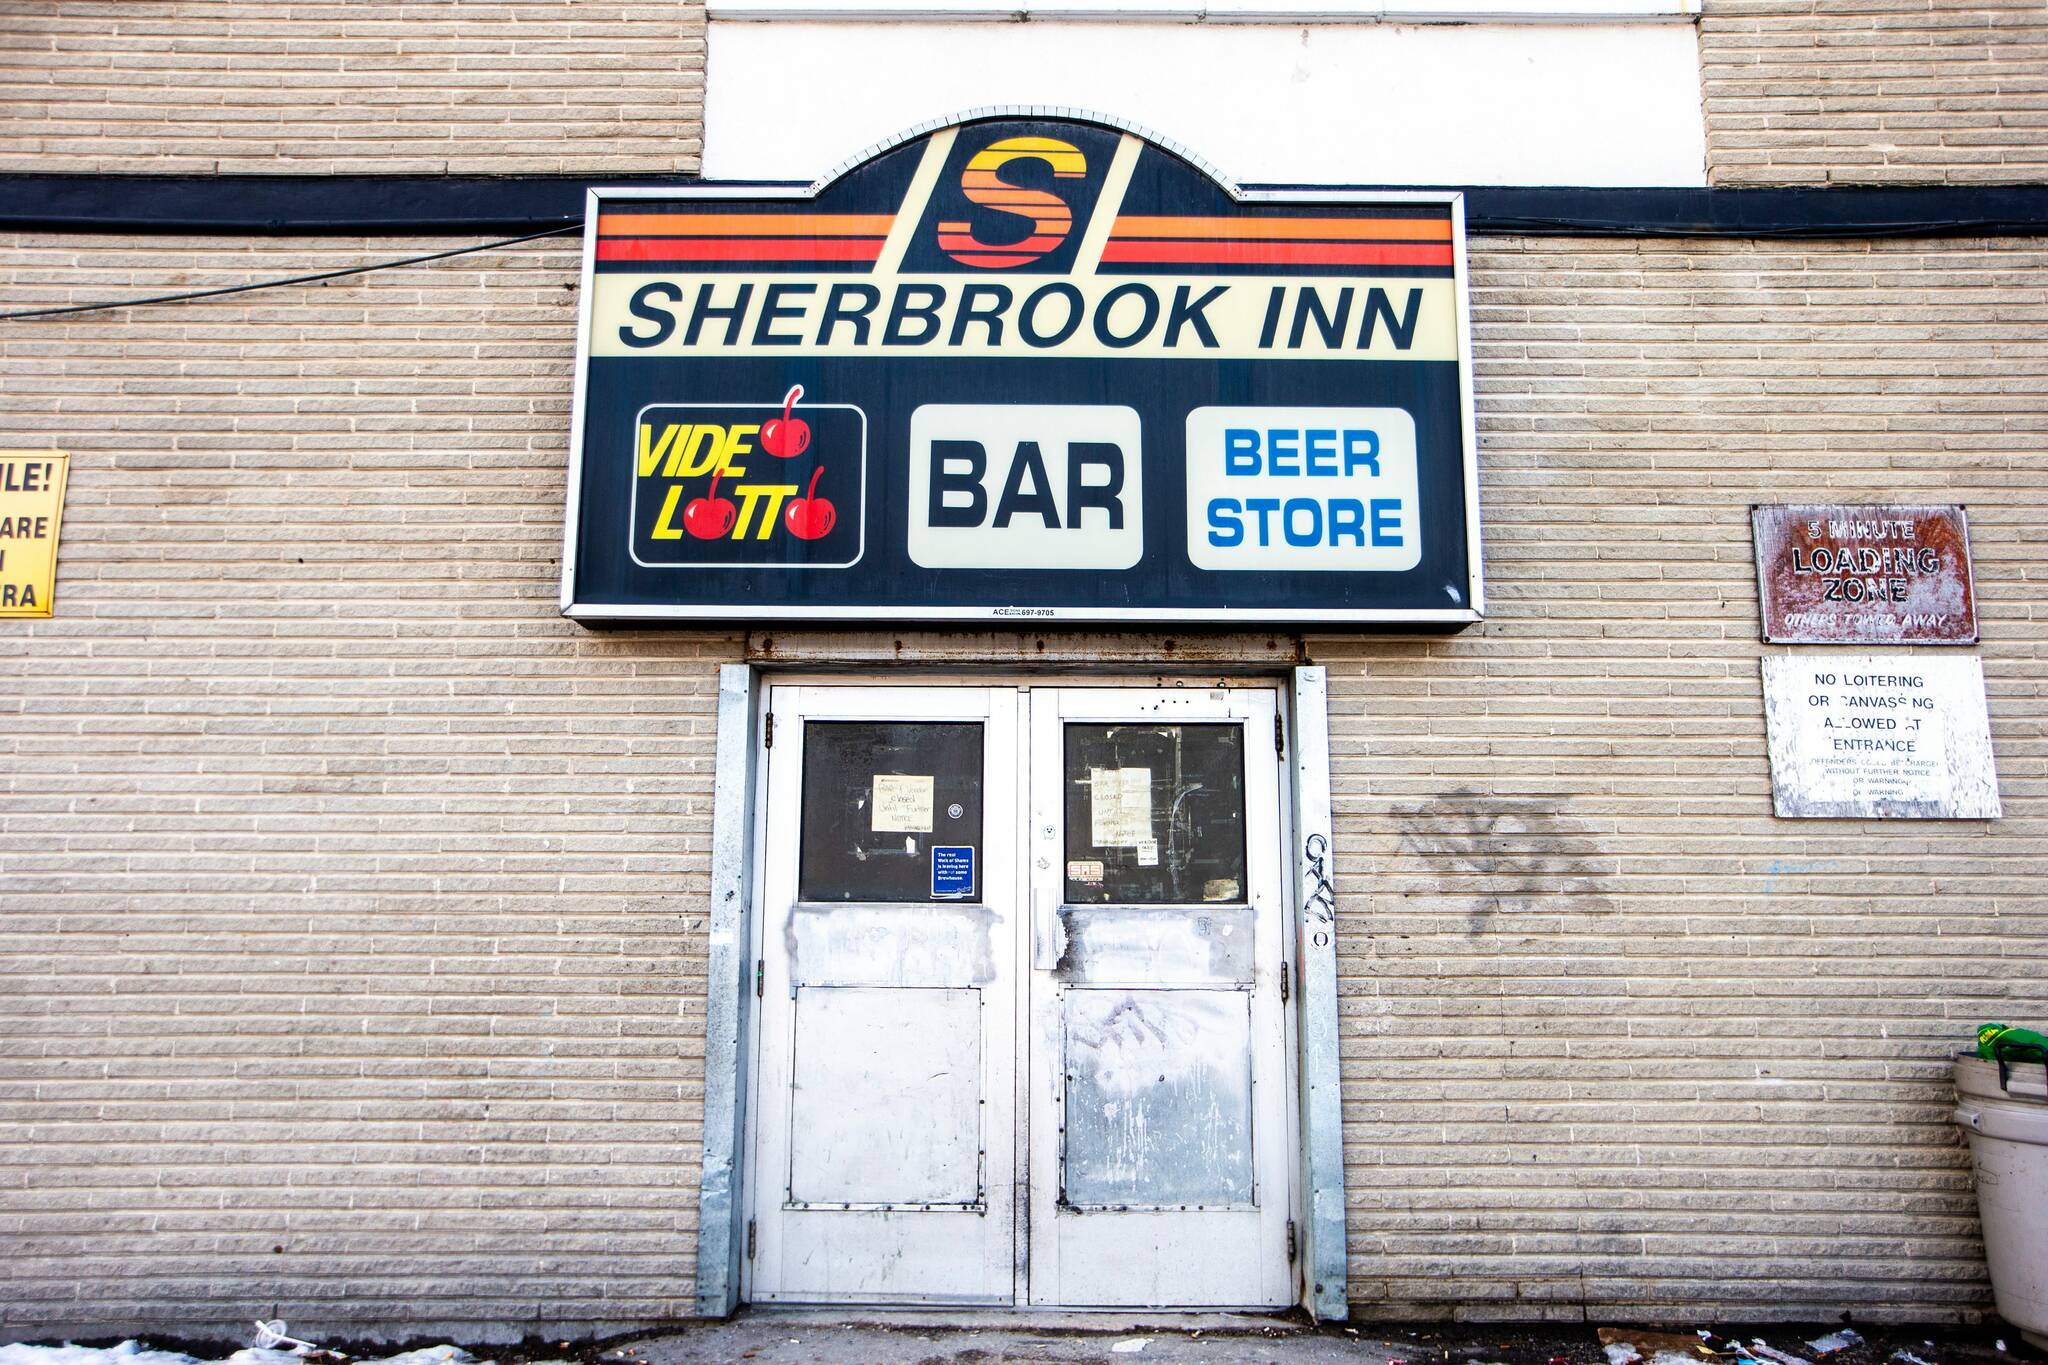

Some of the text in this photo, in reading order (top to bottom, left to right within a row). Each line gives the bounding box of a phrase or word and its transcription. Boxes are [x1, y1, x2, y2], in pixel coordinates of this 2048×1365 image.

[937, 137, 1087, 269] S
[619, 282, 1423, 351] SHERBROOK INN
[1225, 428, 1380, 478] BEER
[929, 439, 1125, 531] BAR
[1207, 498, 1403, 548] STORE
[1829, 520, 1915, 540] MINUTE
[1792, 547, 1940, 575] LOADING
[0, 584, 37, 607] RA
[1823, 577, 1909, 604] ZONE
[1902, 613, 1949, 628] AWAY
[1815, 673, 1924, 688] NO LOITERING
[1808, 695, 1829, 707] OR
[1905, 718, 1922, 731] T
[1834, 738, 1916, 752] ENTRANCE
